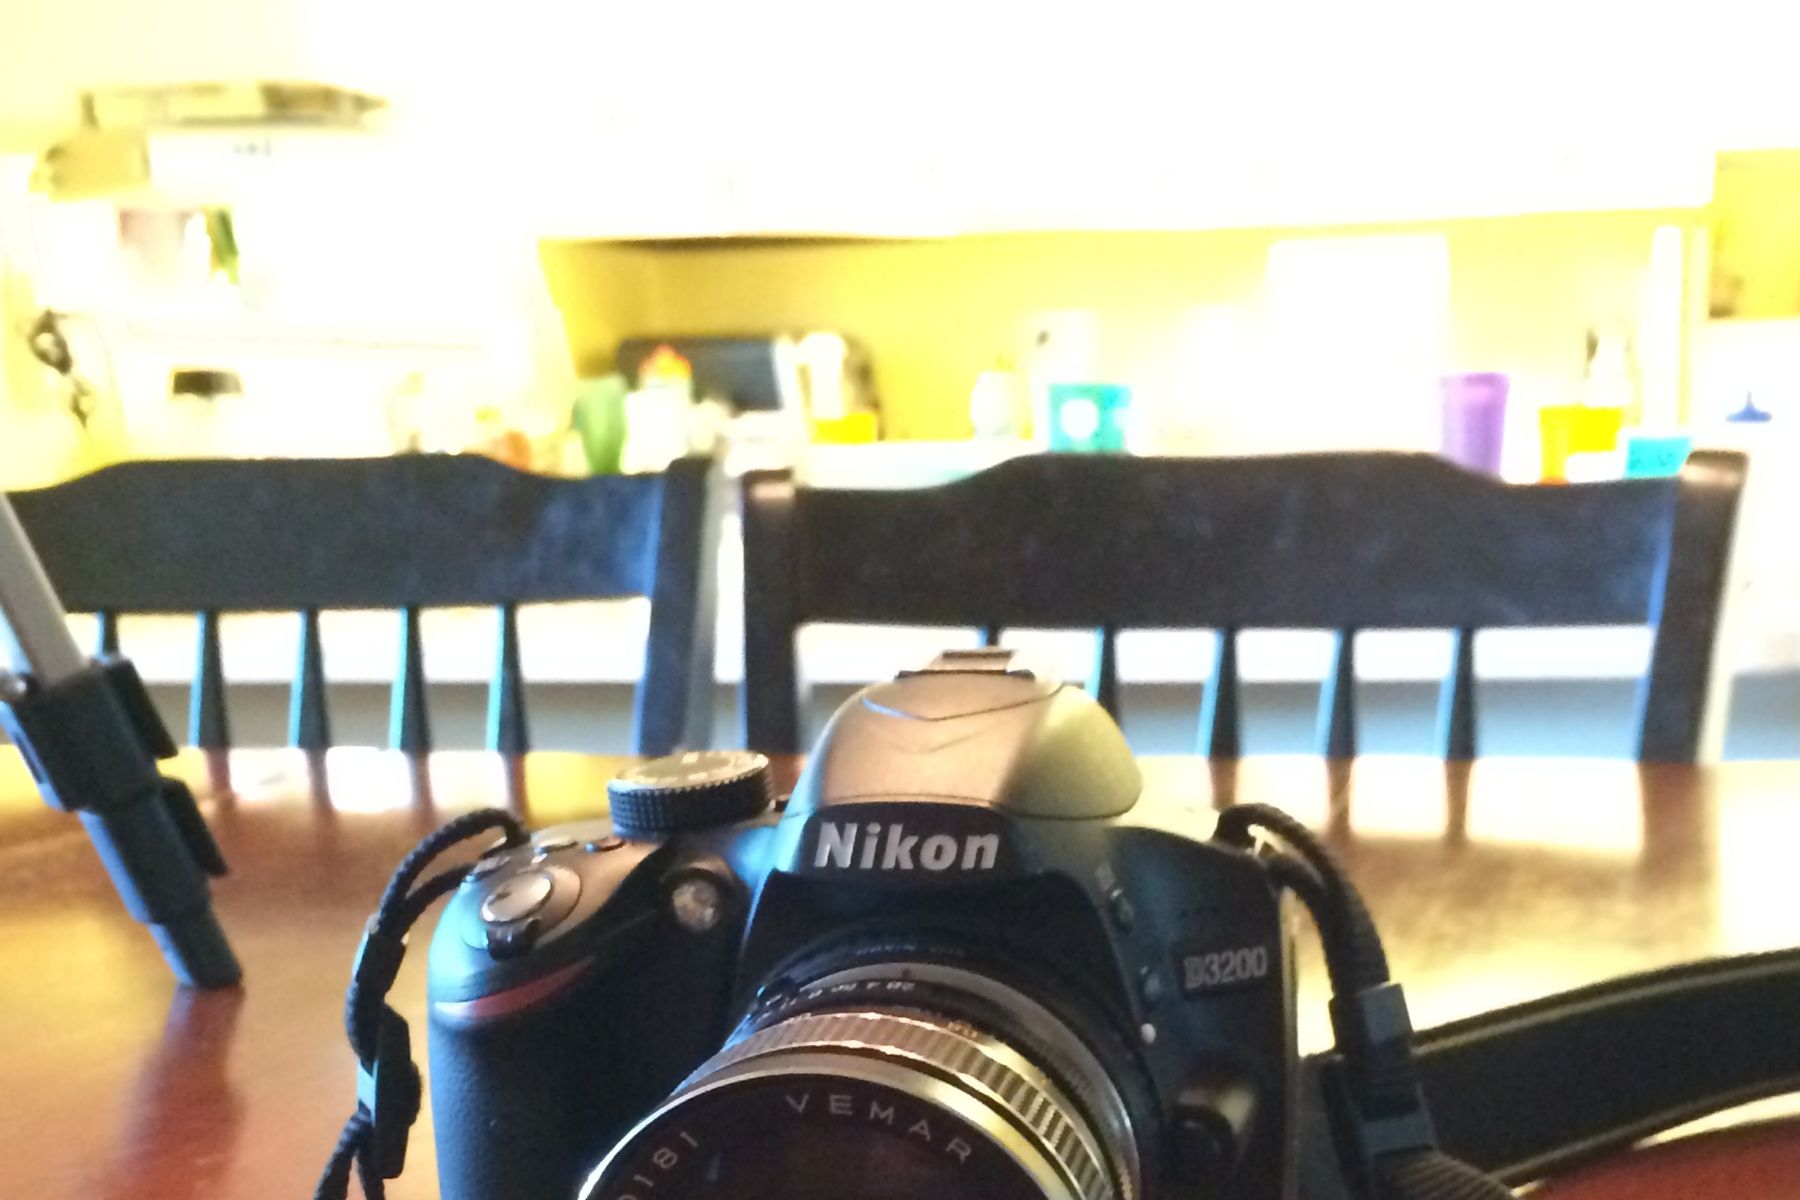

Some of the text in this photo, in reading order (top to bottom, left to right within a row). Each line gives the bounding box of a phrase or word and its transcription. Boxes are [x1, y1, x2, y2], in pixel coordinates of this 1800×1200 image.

[814, 822, 999, 871] Nikon
[1183, 946, 1267, 990] D3200
[786, 1093, 972, 1164] VEMAR
